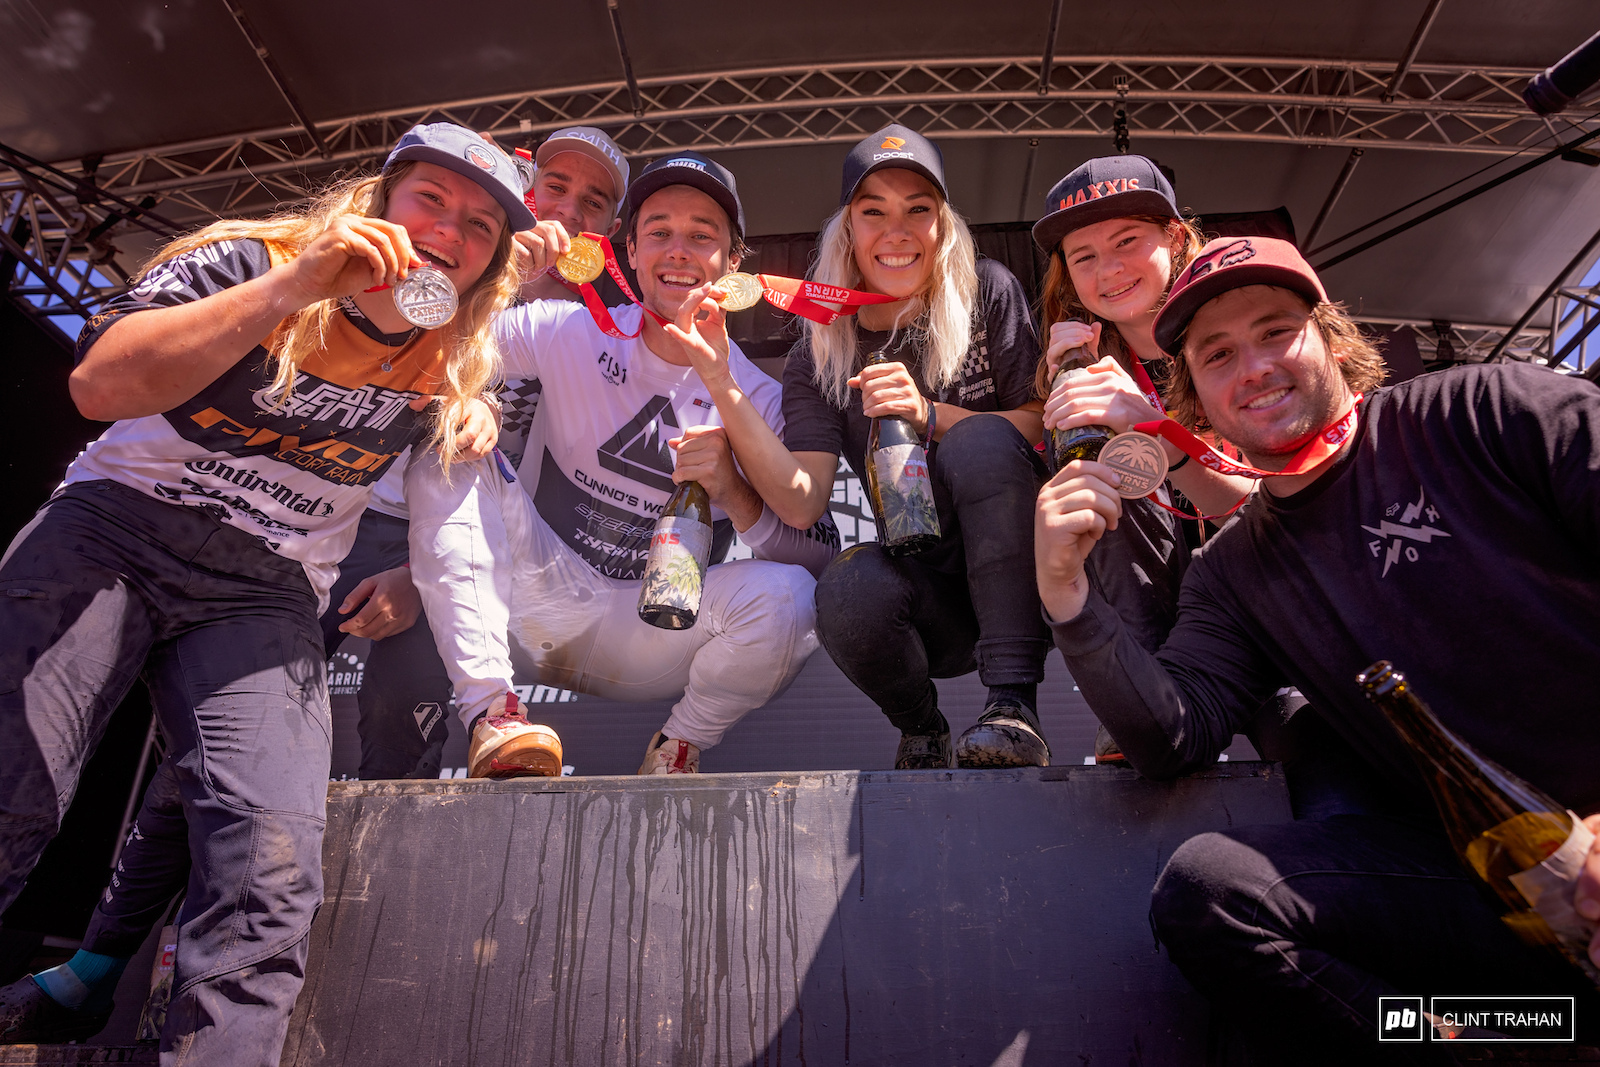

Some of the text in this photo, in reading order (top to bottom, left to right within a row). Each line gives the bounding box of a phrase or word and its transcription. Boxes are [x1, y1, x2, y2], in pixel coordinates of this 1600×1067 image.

[566, 131, 620, 166] SMITH
[873, 152, 914, 160] boost
[1059, 178, 1140, 210] MAXXIS
[804, 283, 850, 299] CAIRNS
[598, 351, 627, 384] FIST
[574, 469, 639, 507] CUNNO'S
[327, 671, 364, 686] ARRIE
